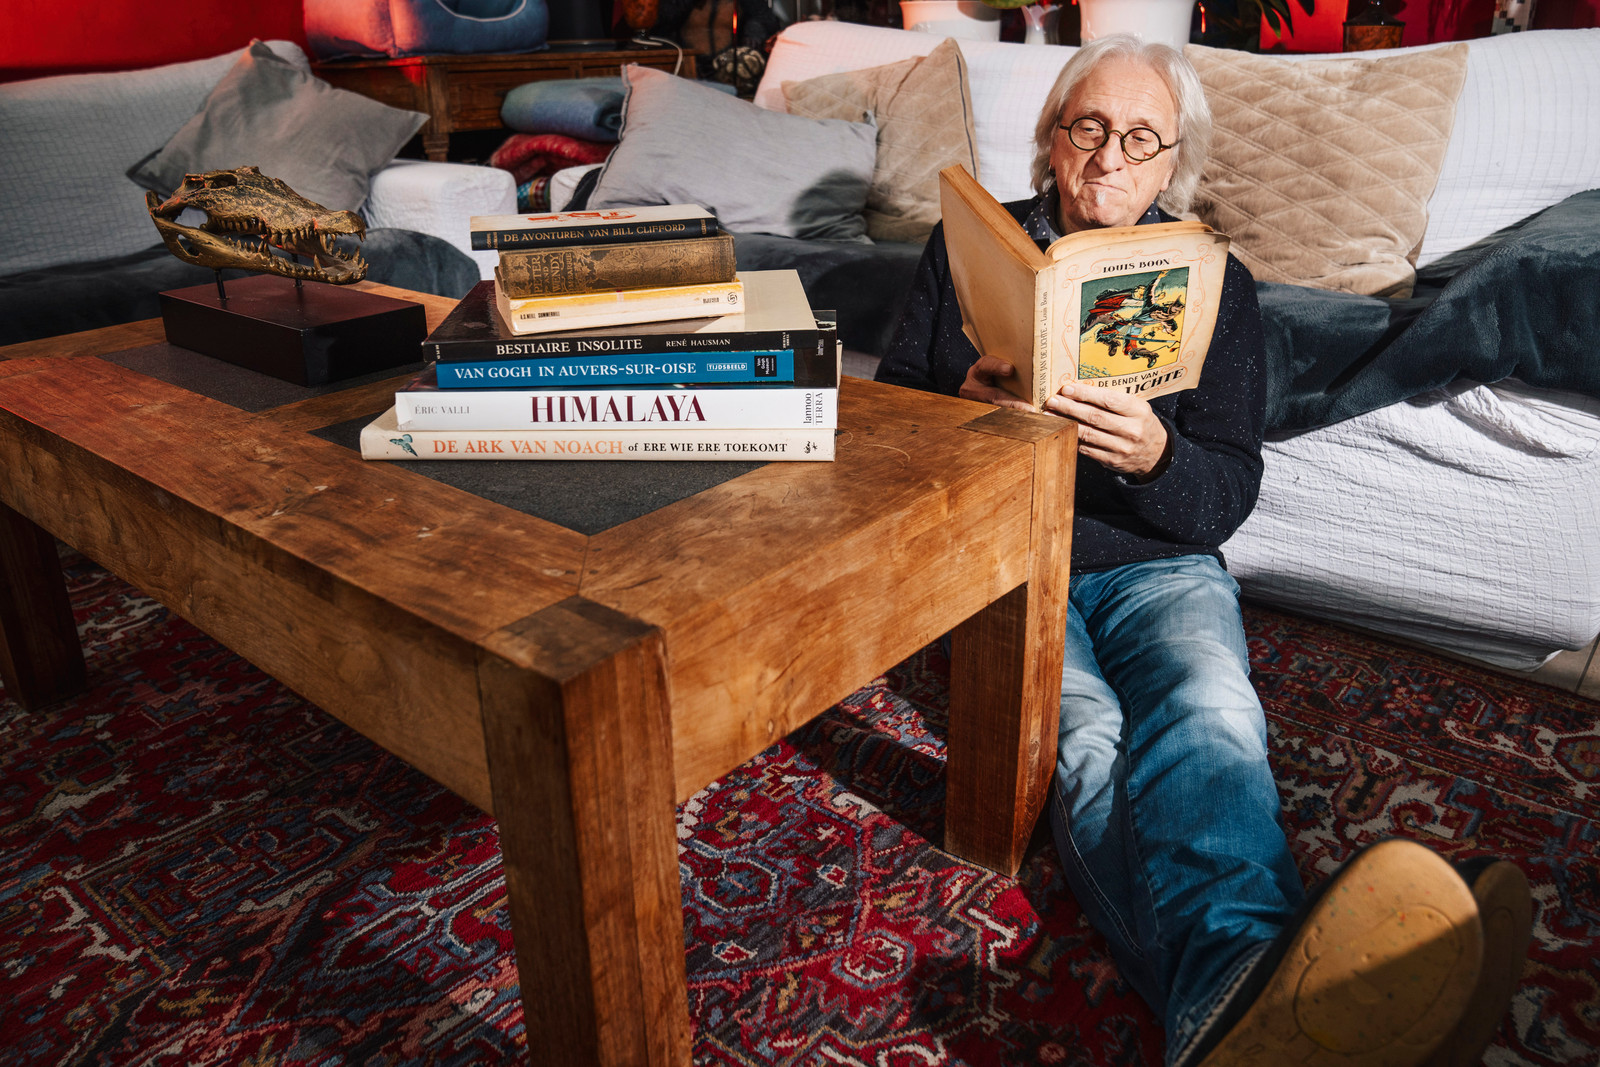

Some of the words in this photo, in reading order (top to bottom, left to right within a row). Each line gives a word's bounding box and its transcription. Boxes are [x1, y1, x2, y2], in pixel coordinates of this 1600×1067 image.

[503, 233, 520, 243] DE
[521, 229, 585, 242] AVONTUREN
[588, 228, 609, 238] VAN
[612, 227, 634, 236] BILL
[636, 223, 686, 235] CLIFFORD
[531, 255, 543, 293] PETER
[549, 254, 562, 293] WENDY
[1102, 262, 1136, 274] LOUIS
[1138, 257, 1171, 269] BOON
[542, 265, 550, 284] AND
[1040, 307, 1048, 322] Louis
[496, 341, 571, 355] BESTIAIRE
[576, 339, 643, 352] INSOLITE
[665, 338, 687, 347] RENÉ
[690, 338, 731, 347] HAUSMAN
[1040, 327, 1048, 350] LICHTE
[1040, 350, 1048, 360] DE
[454, 367, 484, 379] VAN
[487, 366, 532, 378] GOGH
[538, 366, 555, 377] IN
[558, 362, 697, 377] AUVERS-SUR-OISE
[1040, 360, 1048, 371] JAN
[1039, 372, 1047, 386] VAN
[1098, 380, 1109, 388] DE
[1111, 376, 1139, 387] BENDE
[1140, 370, 1159, 381] VAN
[414, 404, 438, 415] ÉRIC
[441, 405, 470, 414] VALLI
[530, 395, 707, 423] HIMALAYA
[803, 392, 812, 424] lannoo
[815, 392, 823, 426] TERRA
[433, 440, 458, 454] DE
[464, 440, 505, 454] ARK
[510, 440, 548, 454] VAN
[553, 440, 624, 454] NOACH
[627, 442, 639, 452] of
[643, 442, 667, 452] ERE
[669, 442, 695, 452] WIE
[697, 442, 721, 452] ERE
[723, 442, 788, 453] TOEKOMT
